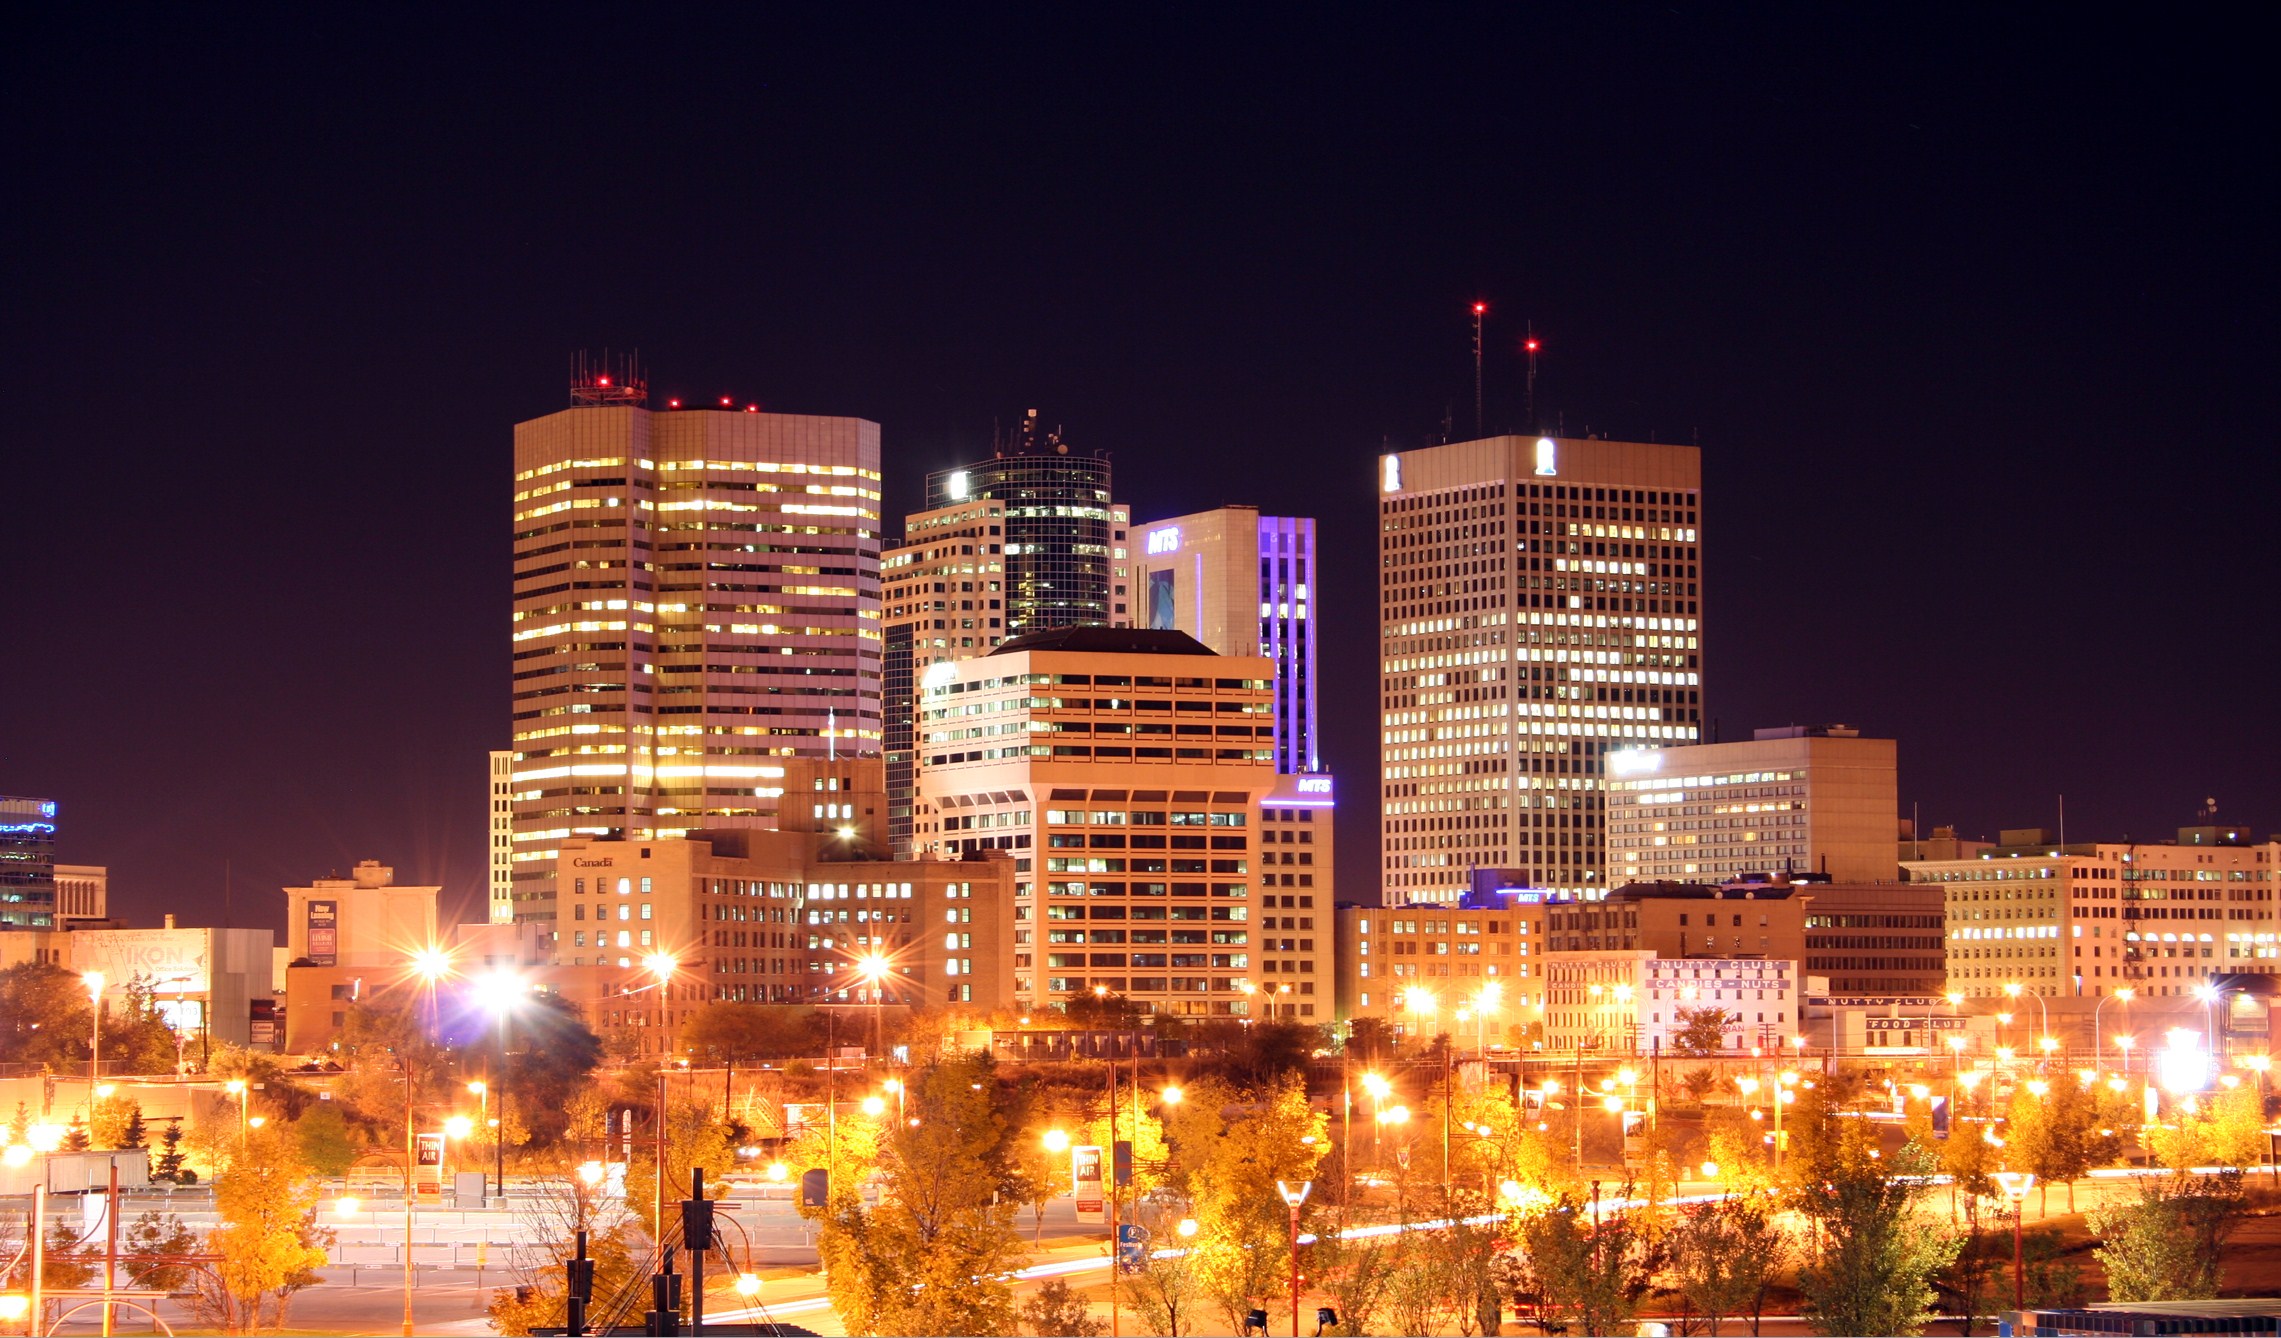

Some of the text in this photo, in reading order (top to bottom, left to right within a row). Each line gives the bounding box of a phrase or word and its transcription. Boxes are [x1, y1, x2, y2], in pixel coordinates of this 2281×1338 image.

[1148, 527, 1179, 555] MTS
[1298, 779, 1331, 793] MTS
[573, 857, 613, 868] Canada
[1518, 893, 1540, 903] MTS
[126, 946, 184, 971] IKON
[1741, 980, 1780, 989] NUTS
[421, 1141, 440, 1151] THIN
[421, 1151, 437, 1161] AIR
[1079, 1165, 1095, 1177] AIR
